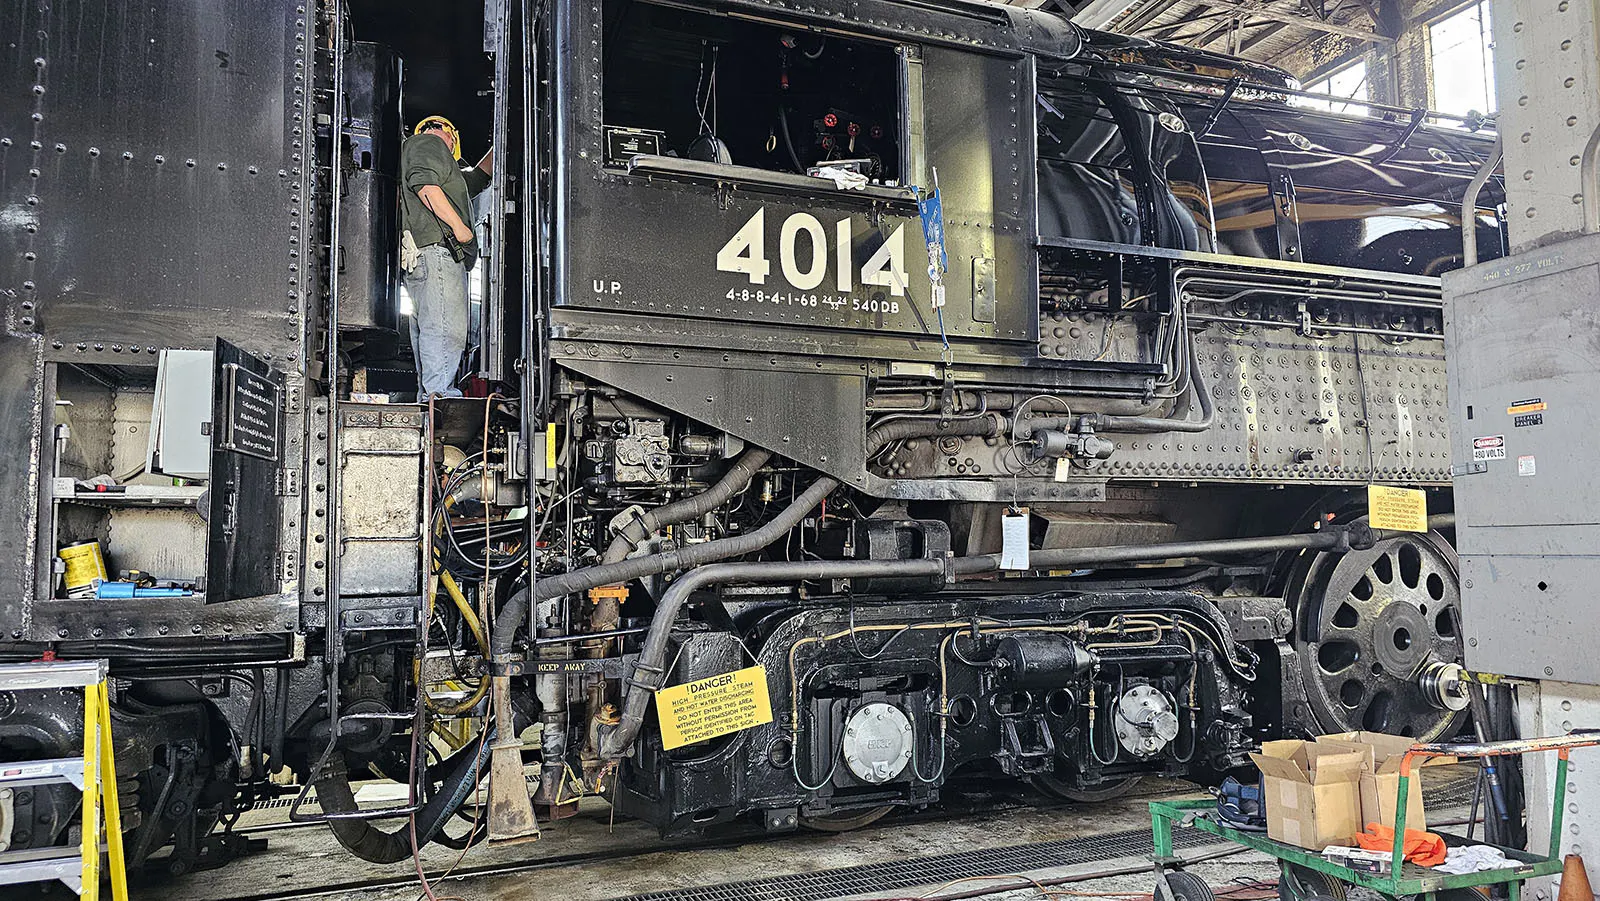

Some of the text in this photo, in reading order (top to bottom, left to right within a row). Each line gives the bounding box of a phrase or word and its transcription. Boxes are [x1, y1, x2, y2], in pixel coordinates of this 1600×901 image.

[716, 205, 908, 297] 4014
[726, 287, 818, 307] 4-8-8-4-1-68
[1486, 448, 1504, 458] VOLTS
[538, 663, 586, 672] KEEP AWAY
[671, 682, 753, 706] HIGH PRESSURE STEAM
[674, 706, 685, 714] AND
[700, 698, 718, 706] WATER
[719, 688, 754, 702] DISCHARGING
[704, 705, 722, 714] ENTER
[725, 701, 736, 709] THIS
[739, 697, 752, 705] AREA
[676, 704, 757, 729] WITHOUT PERMISSION FROM
[681, 725, 702, 735] PERSON
[704, 717, 733, 729] IDENTIFIED
[684, 729, 714, 742] ATTACHED
[740, 719, 753, 727] SIGN
